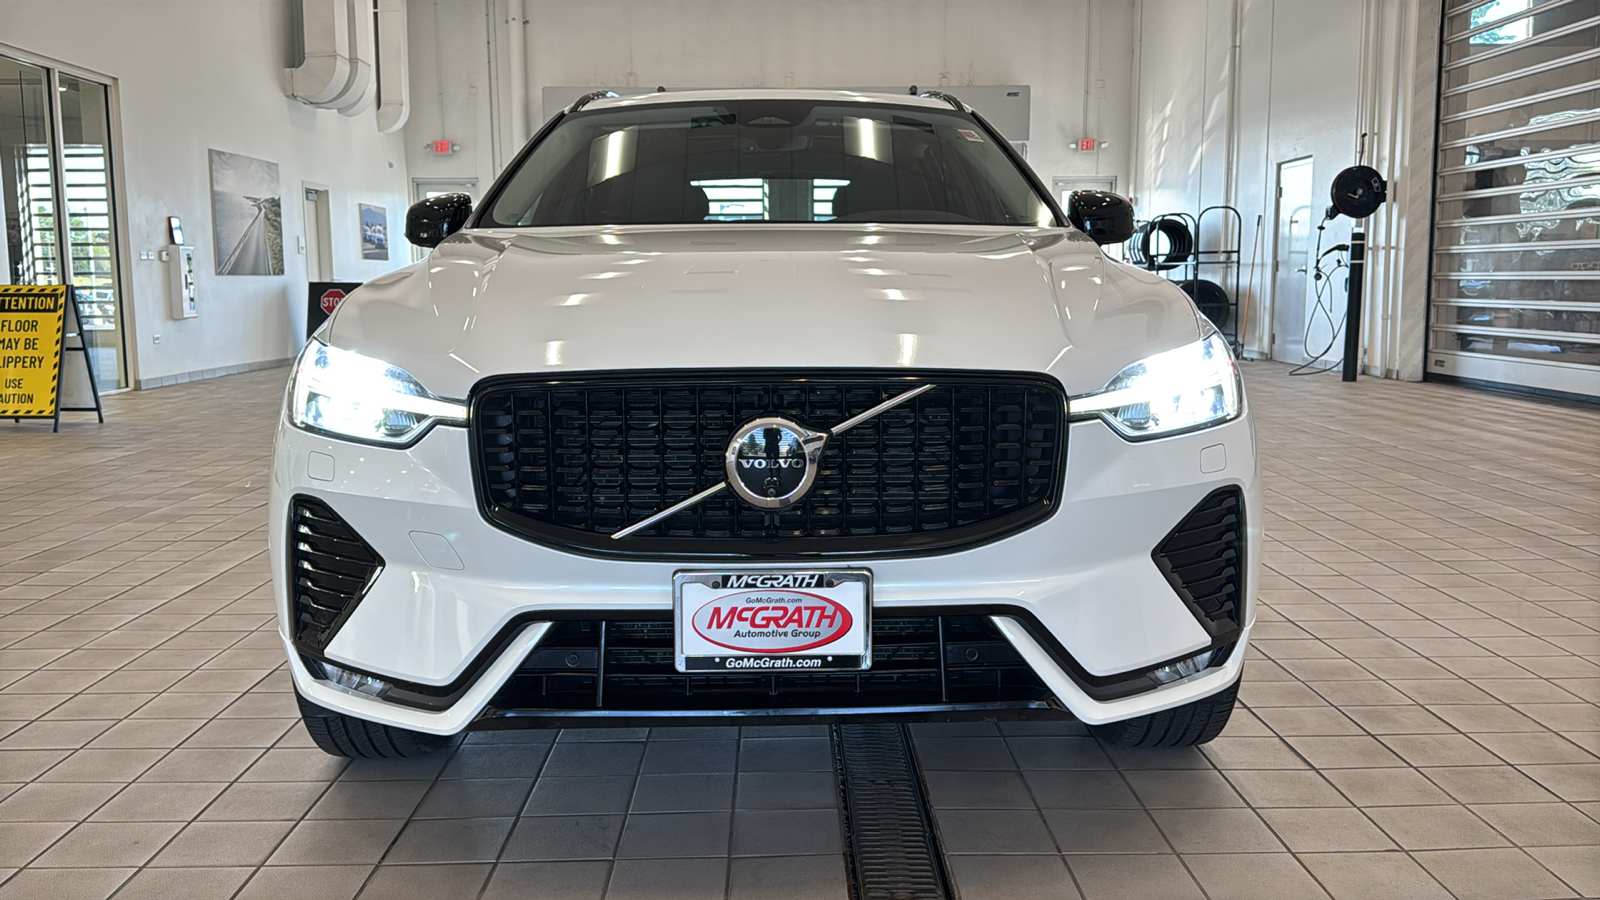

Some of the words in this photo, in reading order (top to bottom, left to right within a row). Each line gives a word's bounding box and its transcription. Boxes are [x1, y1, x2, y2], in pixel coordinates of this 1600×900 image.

[435, 141, 449, 153] EXIT
[1081, 139, 1095, 151] EXIT
[323, 297, 343, 307] STO
[1, 320, 38, 332] FLOOR
[24, 338, 39, 350] BE
[0, 356, 44, 368] IPPERY
[5, 378, 23, 389] USE
[739, 459, 803, 468] VOLVO
[734, 629, 788, 638] Automotive
[791, 629, 820, 639] Group
[726, 657, 821, 668] GoMcGrath.com
